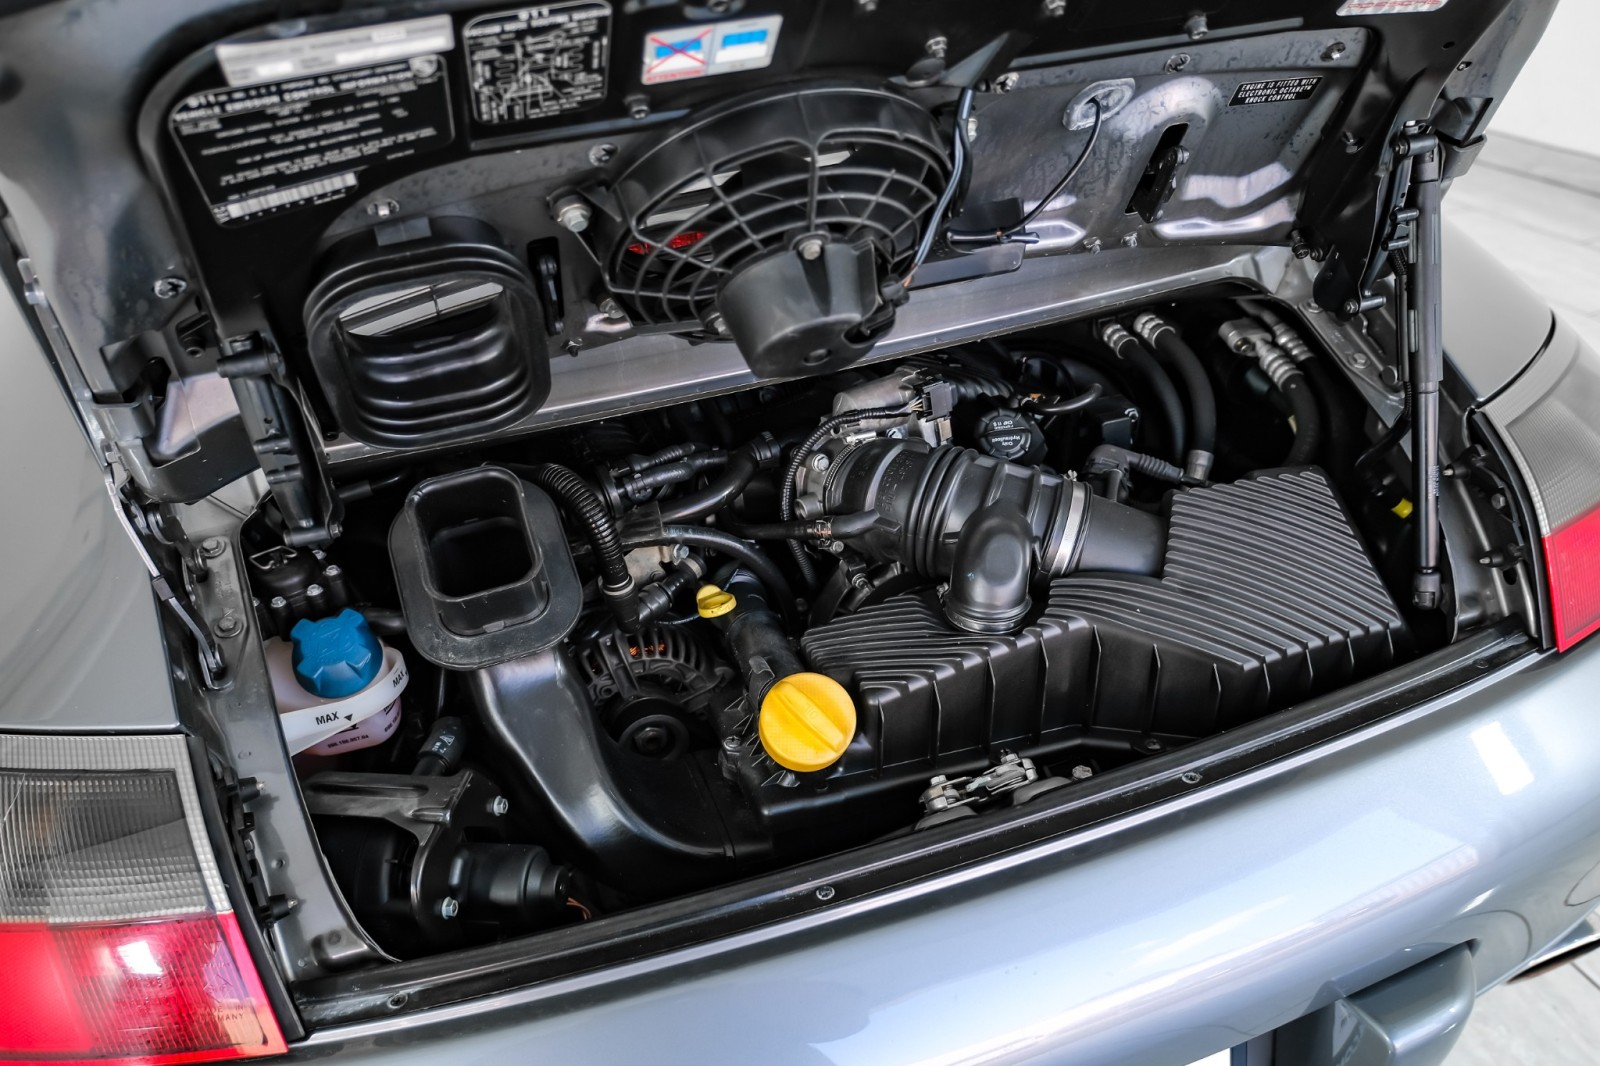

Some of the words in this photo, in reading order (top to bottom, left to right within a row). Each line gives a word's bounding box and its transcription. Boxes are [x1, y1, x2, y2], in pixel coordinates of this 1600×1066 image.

[1241, 82, 1266, 91] ENGINE
[283, 85, 335, 102] CONTROL
[1238, 88, 1277, 98] ELECTRONIC
[1245, 96, 1267, 104] KNOCK
[1268, 93, 1296, 102] CONTROL
[392, 671, 405, 688] MAX
[315, 711, 339, 725] MAX
